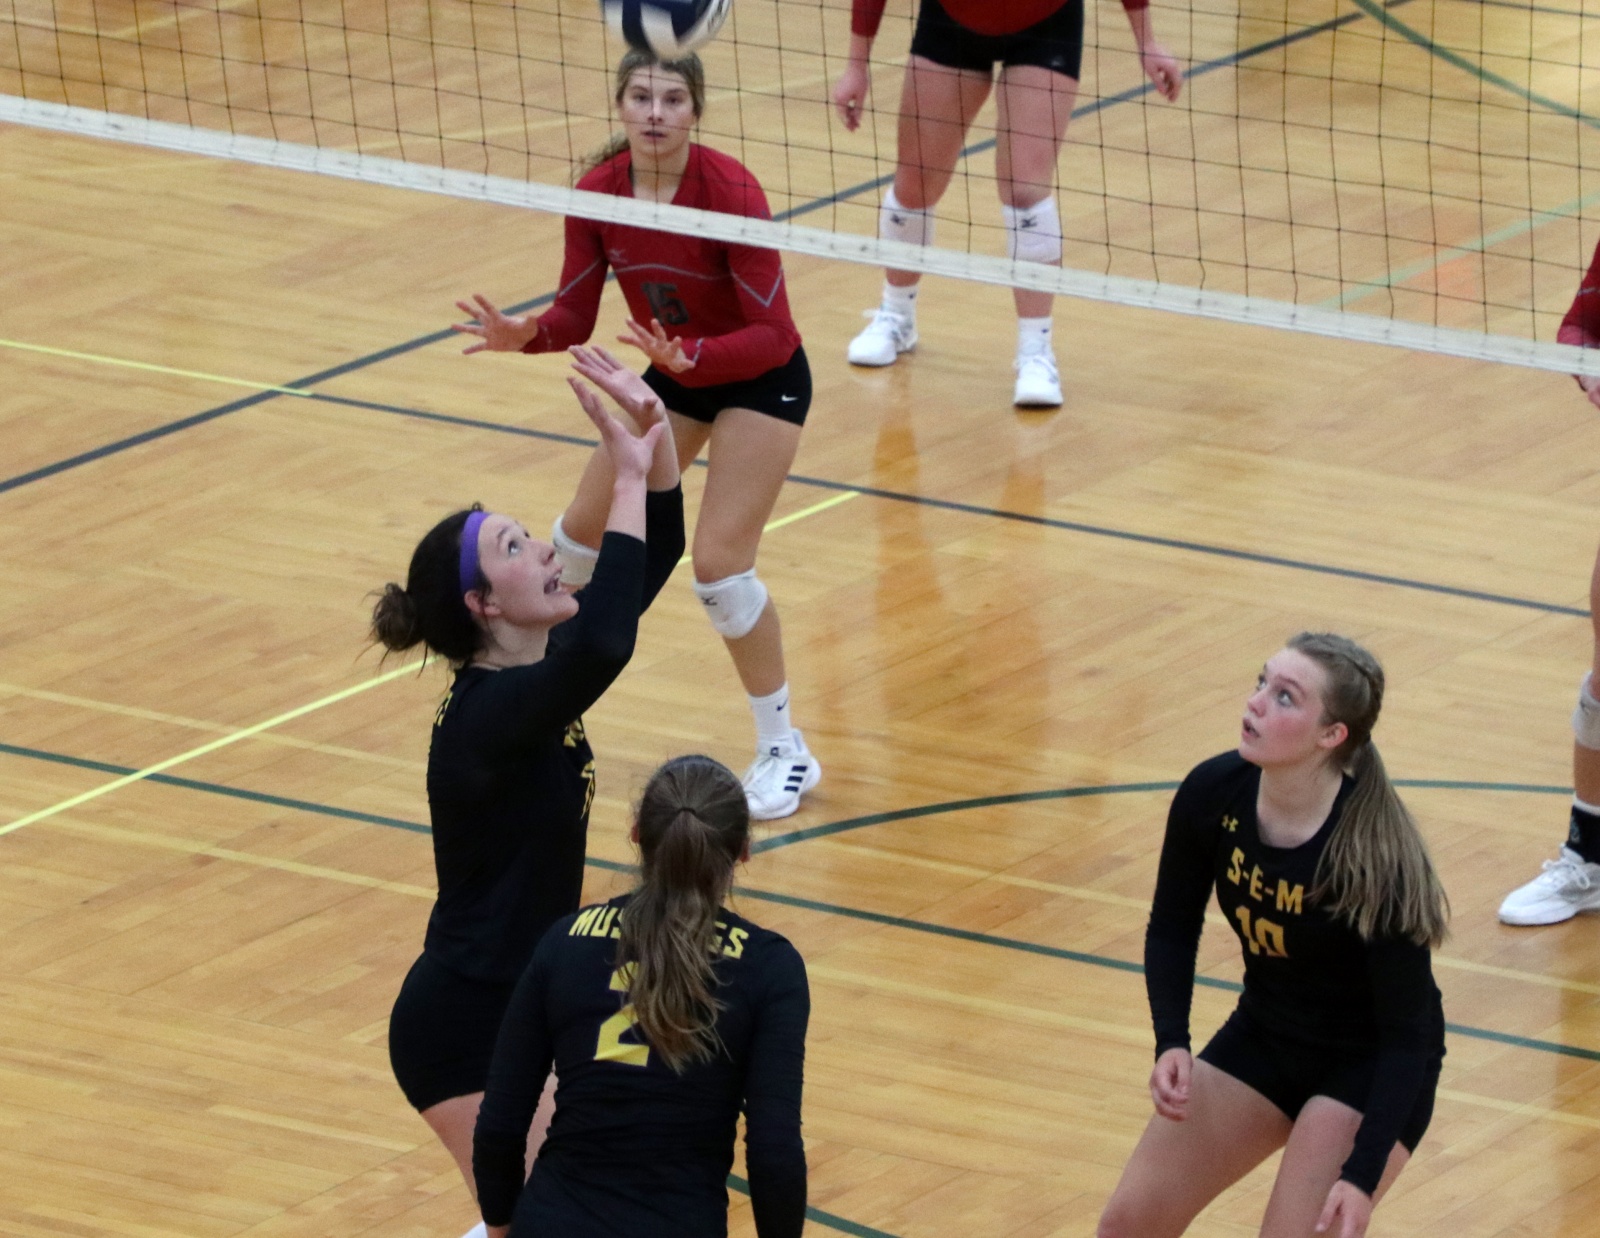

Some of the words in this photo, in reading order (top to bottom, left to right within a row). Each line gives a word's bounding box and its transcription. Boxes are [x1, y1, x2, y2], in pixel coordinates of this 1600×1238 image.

[640, 282, 690, 326] 15
[1226, 846, 1305, 915] S-E-M
[1235, 905, 1289, 958] 10
